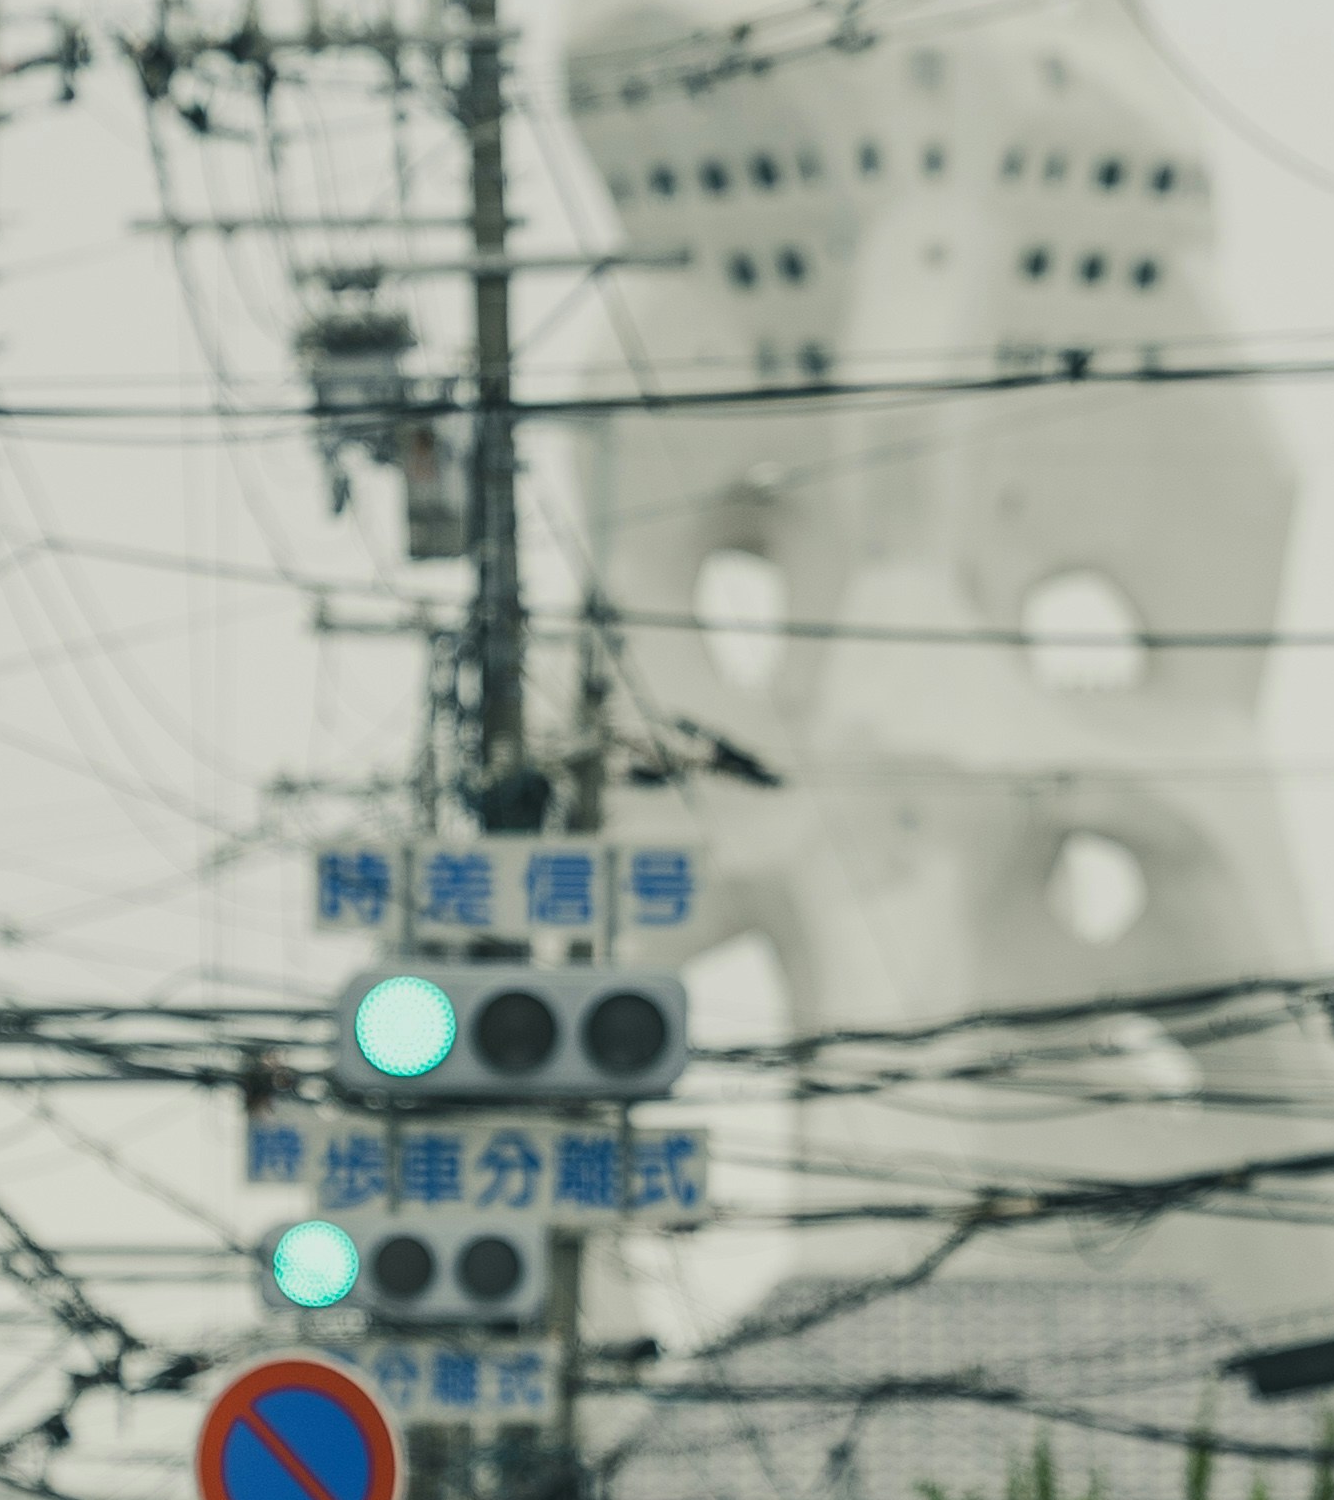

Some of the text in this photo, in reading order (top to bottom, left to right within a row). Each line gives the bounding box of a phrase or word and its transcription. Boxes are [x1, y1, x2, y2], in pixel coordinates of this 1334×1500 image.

[319, 851, 693, 925] 時差信号
[319, 1128, 698, 1210] 歩車分離式
